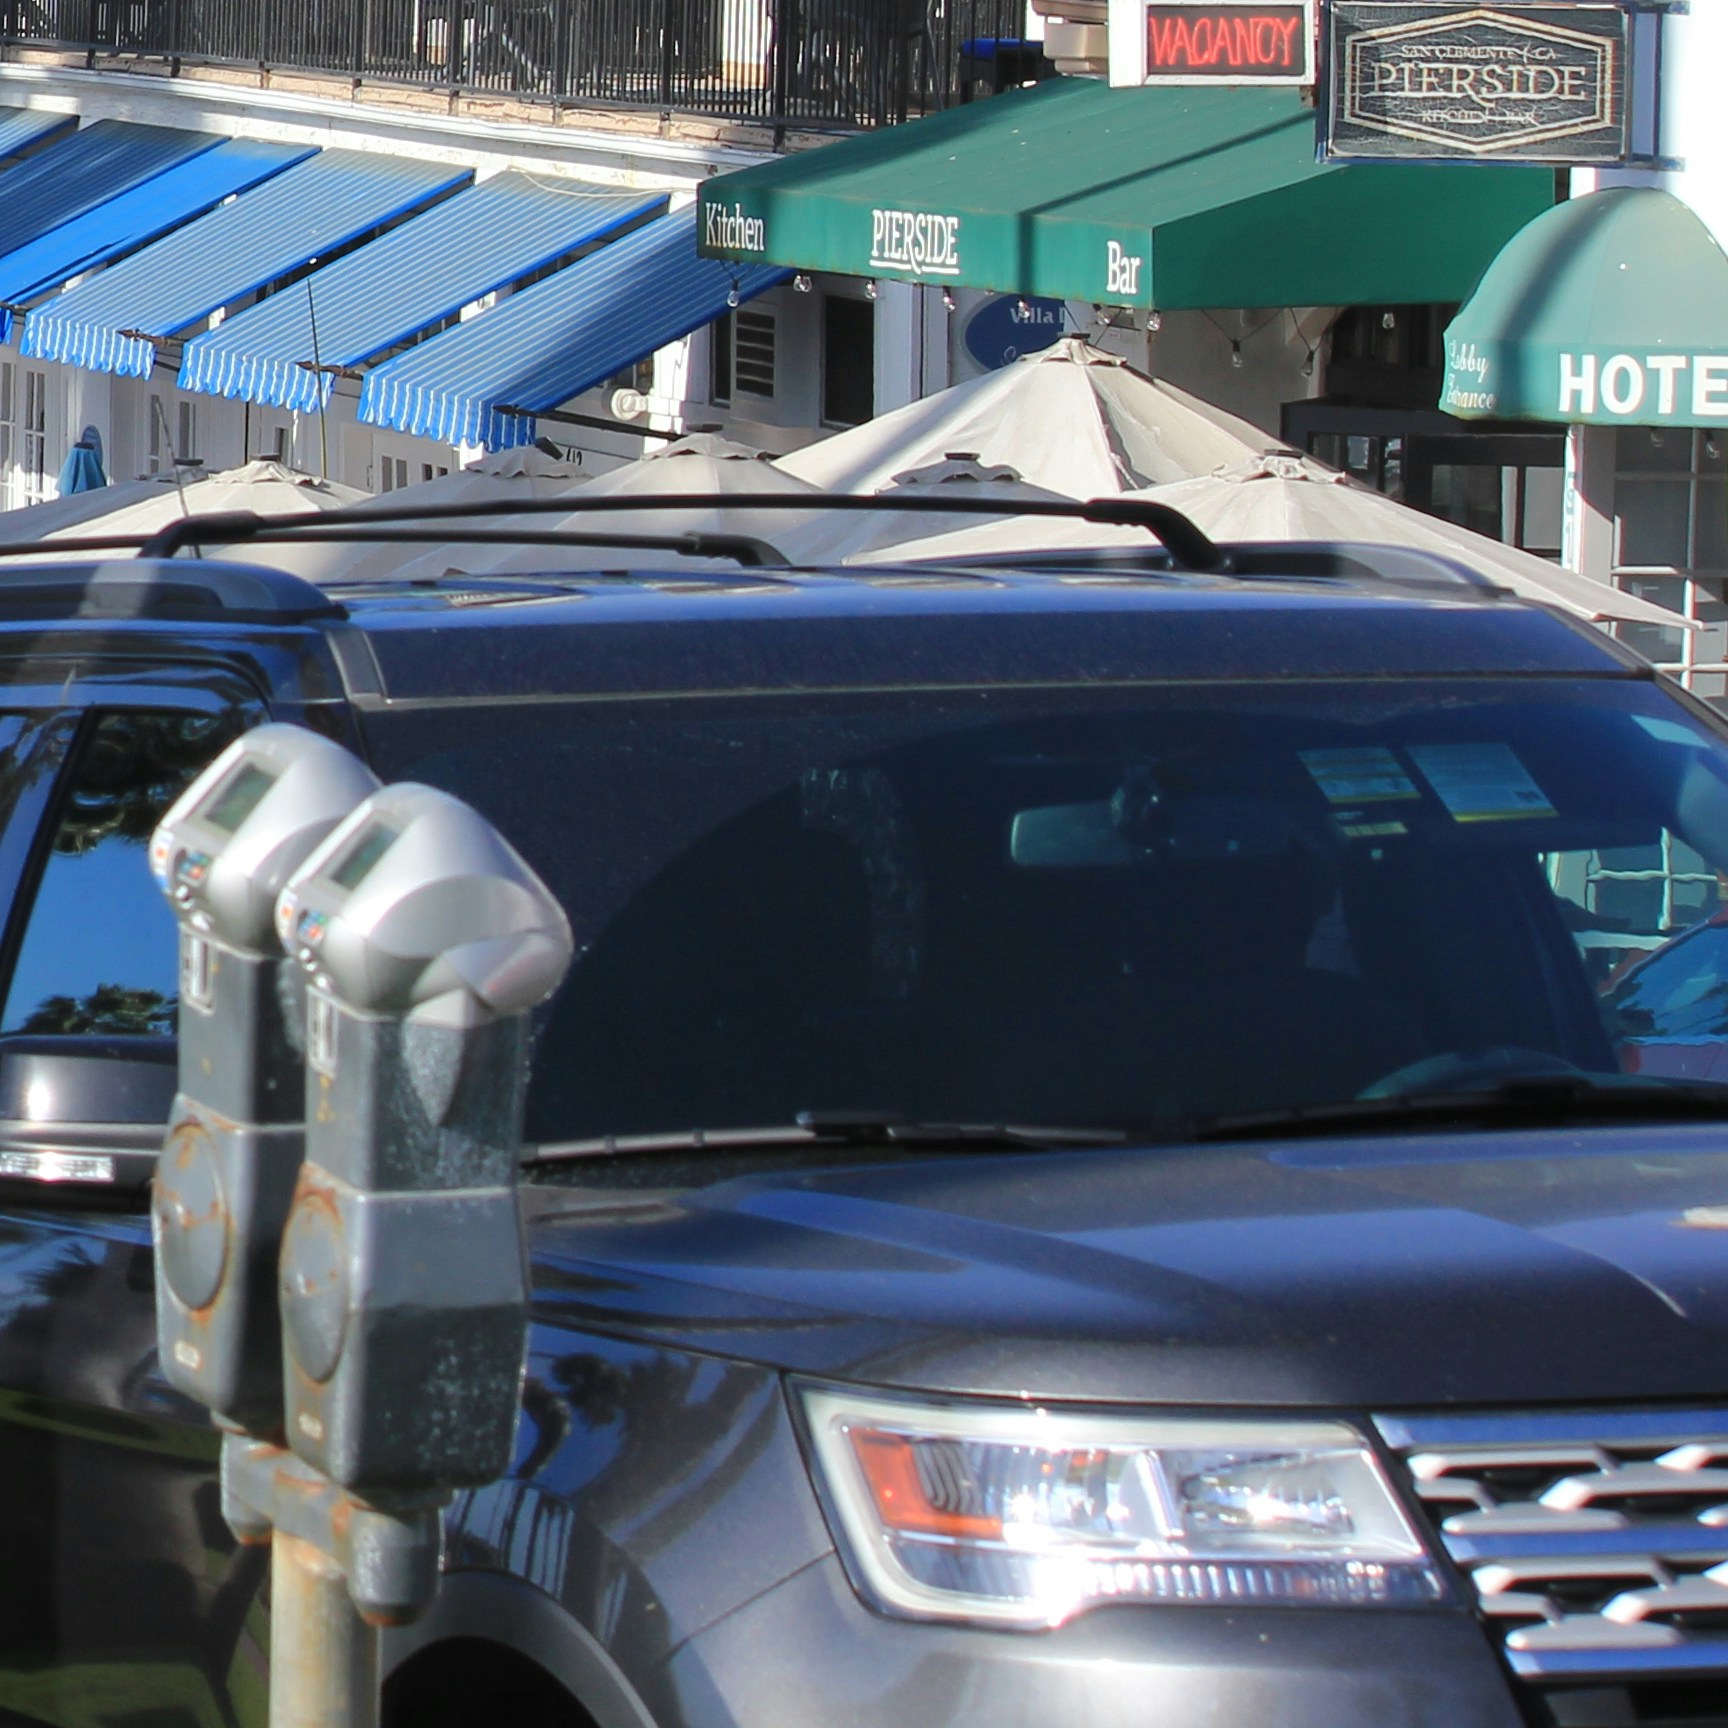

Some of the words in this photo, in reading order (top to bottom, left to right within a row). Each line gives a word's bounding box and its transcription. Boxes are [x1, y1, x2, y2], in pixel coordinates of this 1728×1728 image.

[1149, 16, 1300, 66] VACANCY
[1373, 61, 1587, 106] PIERSIDE
[705, 202, 765, 251] Kitchen
[871, 209, 959, 272] PIERSIDE
[1106, 240, 1141, 295] Bar
[1448, 339, 1490, 383] Lobby
[1447, 374, 1495, 410] Entrance
